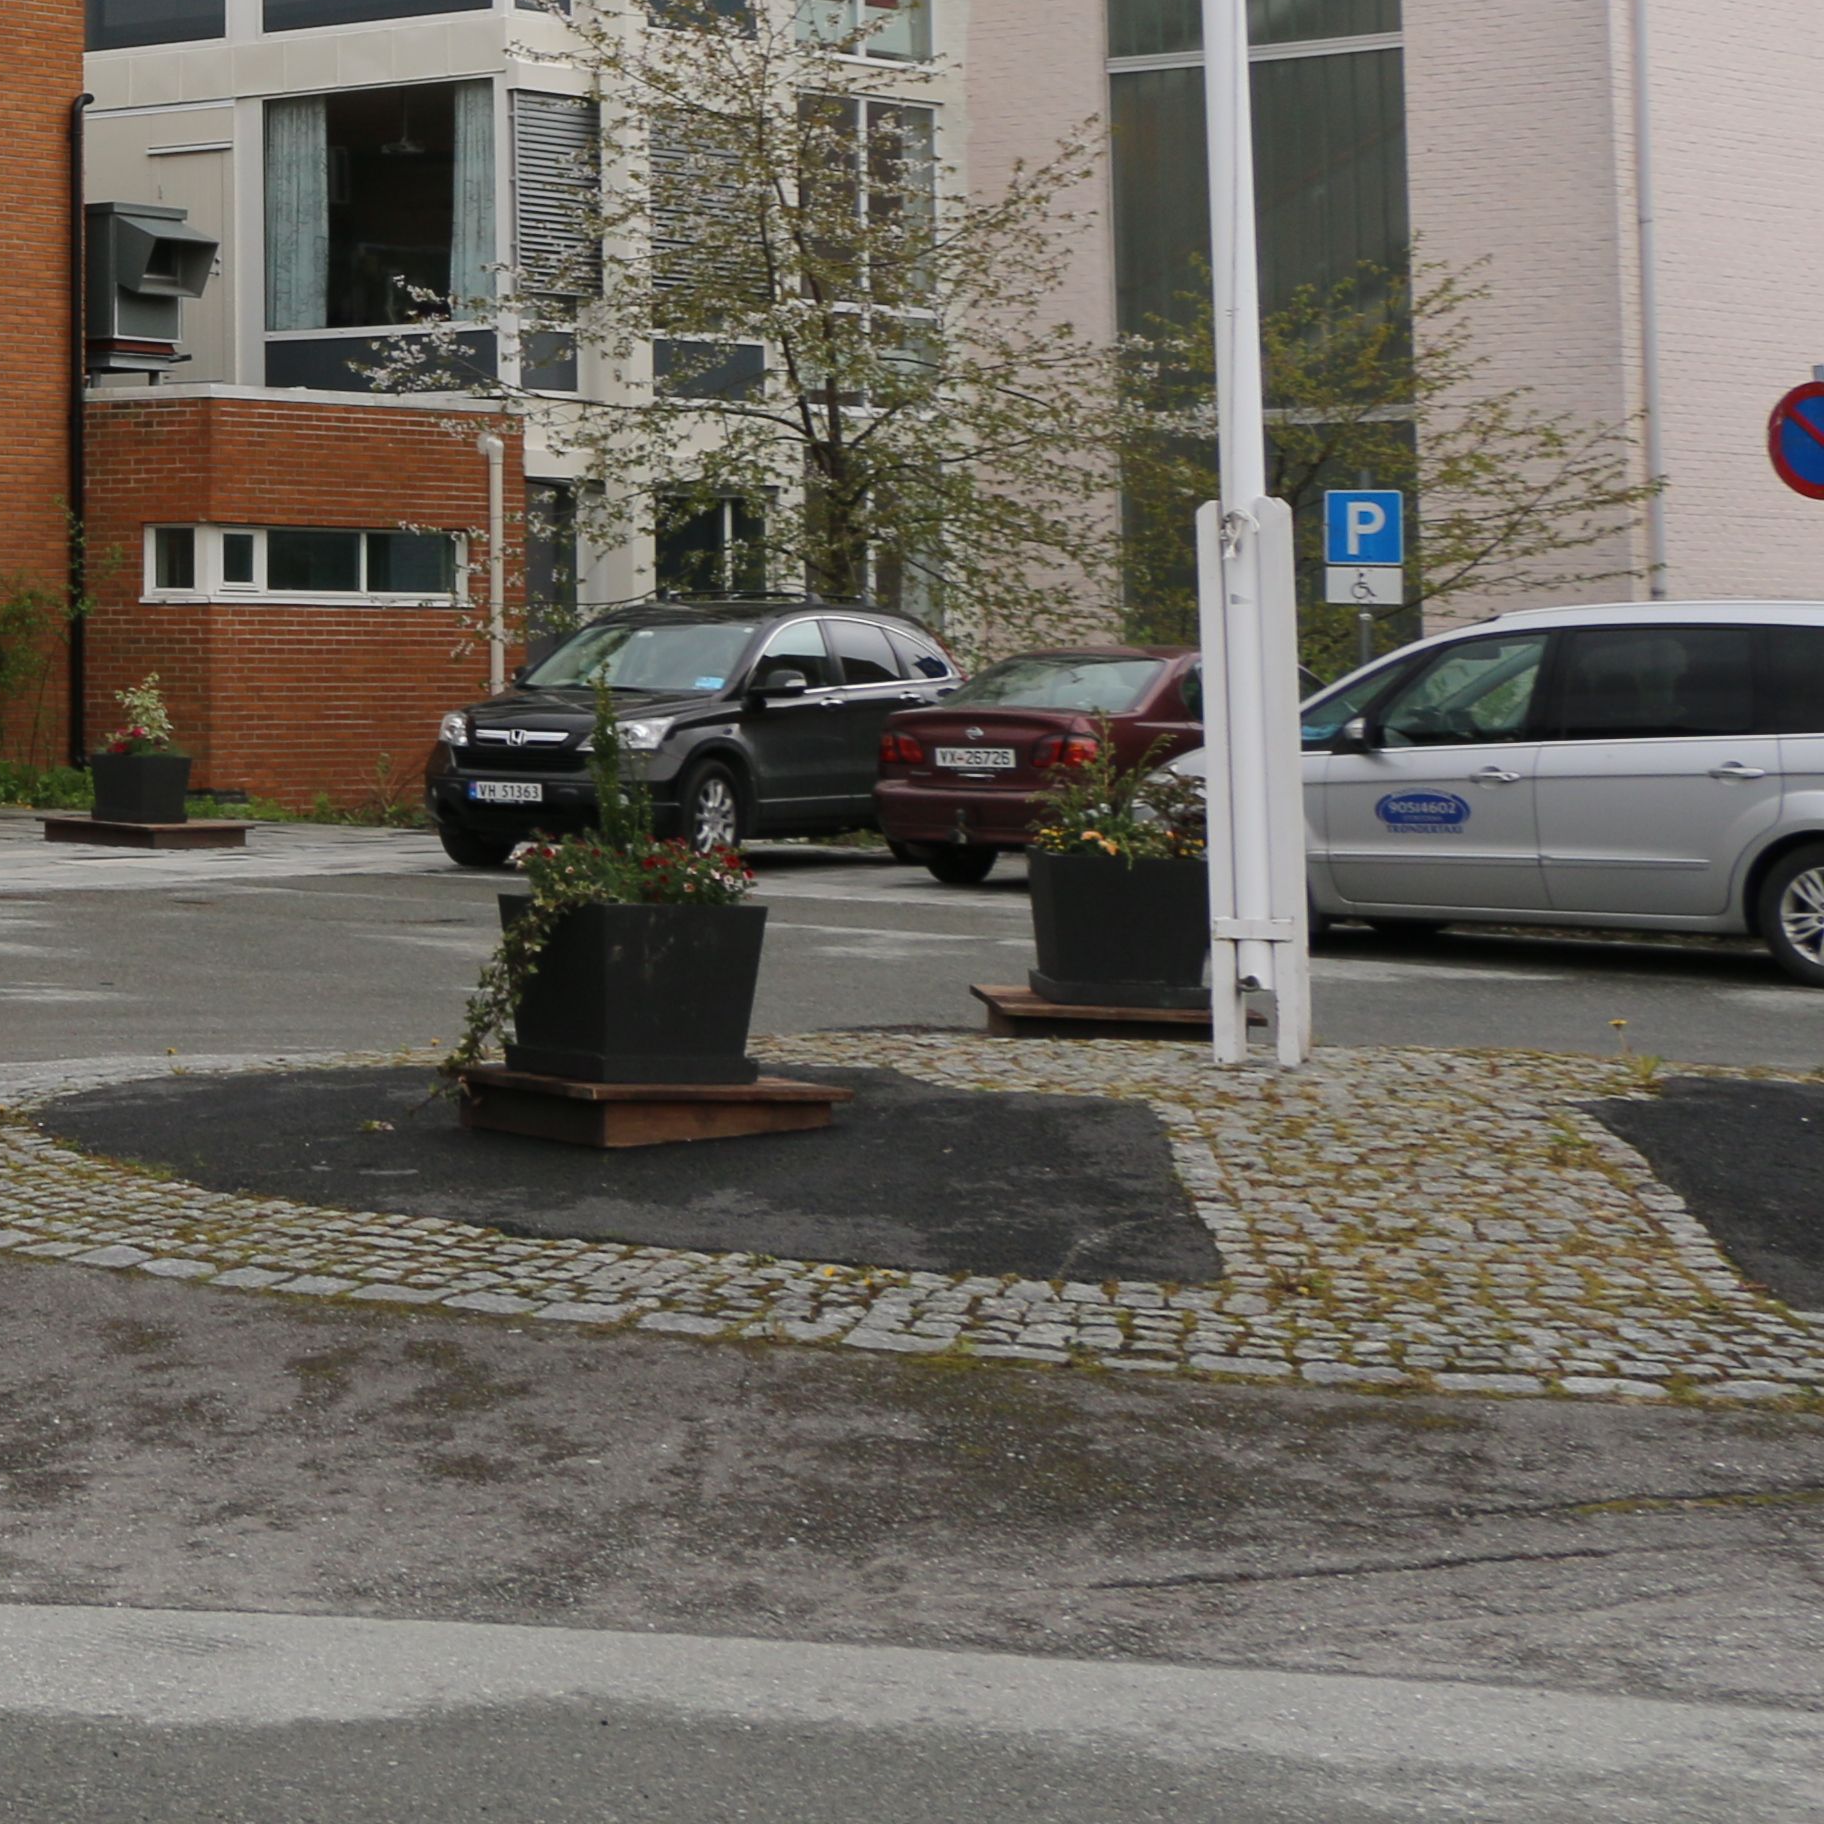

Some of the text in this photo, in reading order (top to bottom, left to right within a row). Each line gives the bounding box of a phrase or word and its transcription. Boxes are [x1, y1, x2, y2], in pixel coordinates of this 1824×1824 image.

[1347, 501, 1386, 555] P
[479, 784, 539, 798] VH 51363
